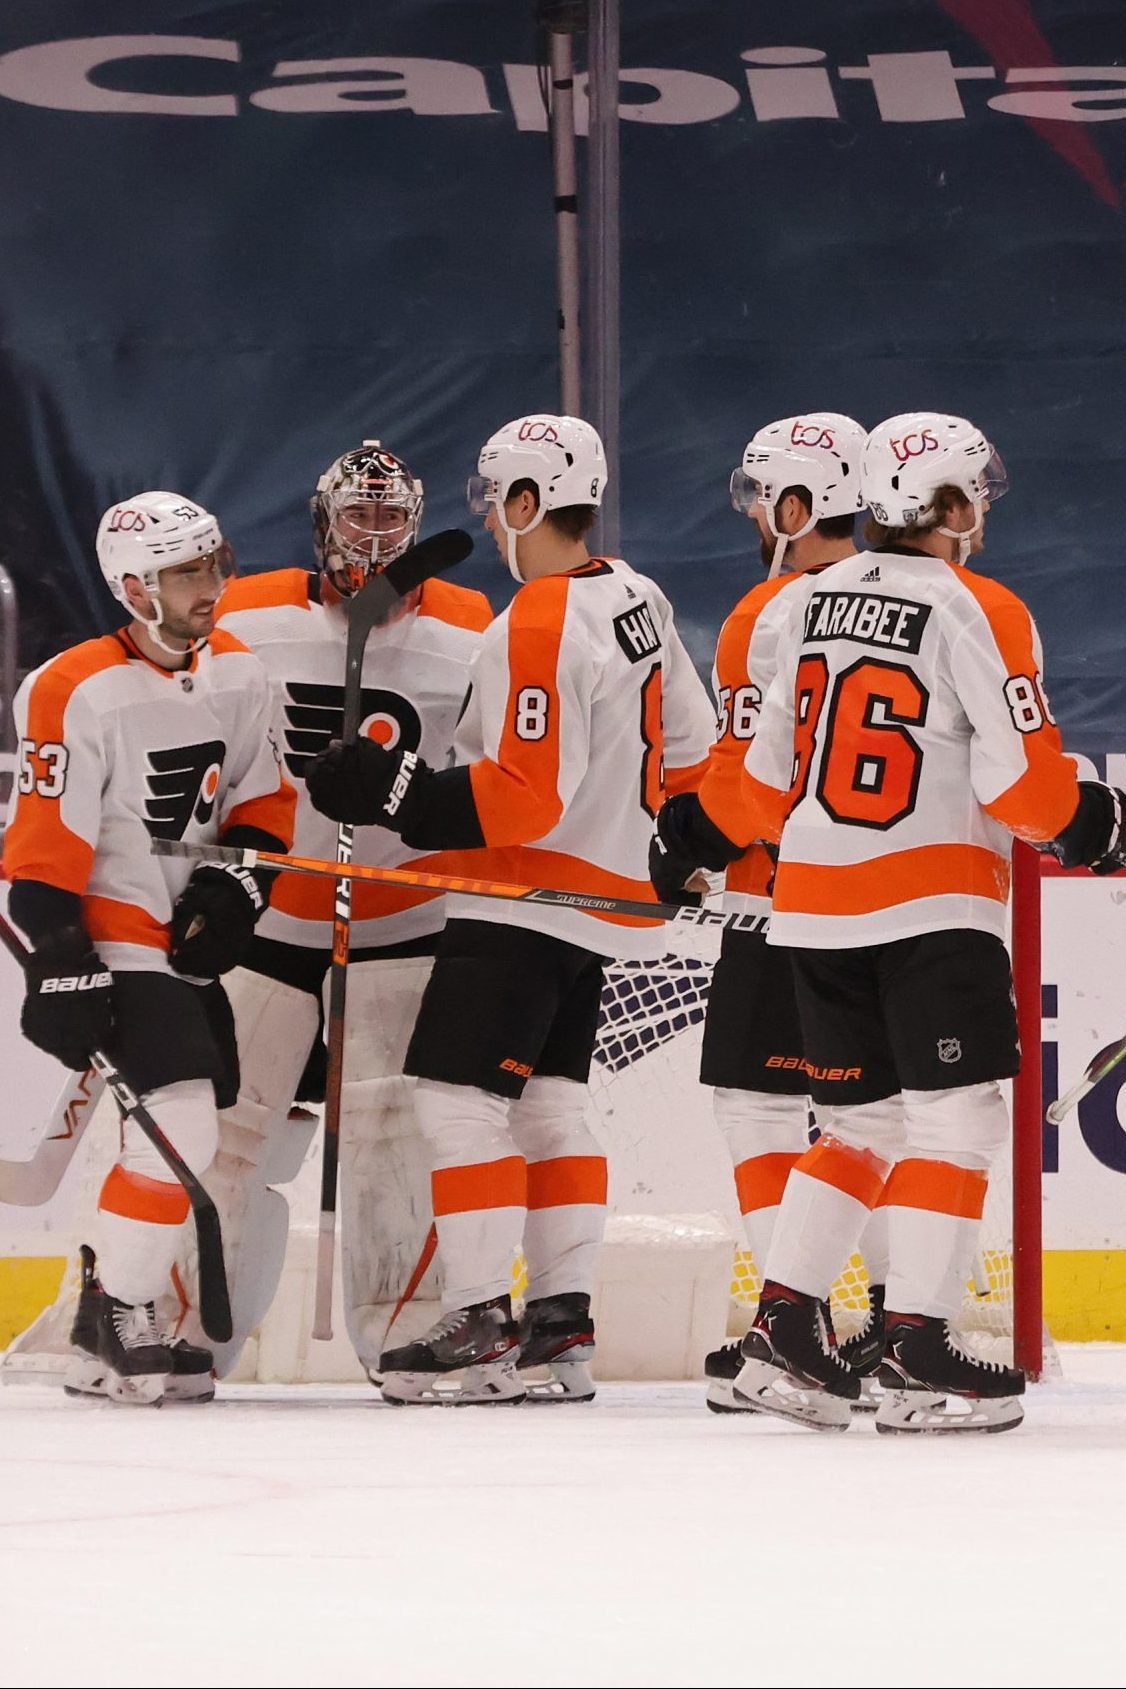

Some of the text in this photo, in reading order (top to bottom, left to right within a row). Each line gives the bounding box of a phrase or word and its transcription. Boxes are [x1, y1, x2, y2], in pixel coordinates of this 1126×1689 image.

[790, 421, 836, 450] tcs
[890, 428, 940, 461] tcs
[804, 595, 920, 647] FARABEE
[514, 686, 549, 742] 8
[17, 737, 70, 799] 53
